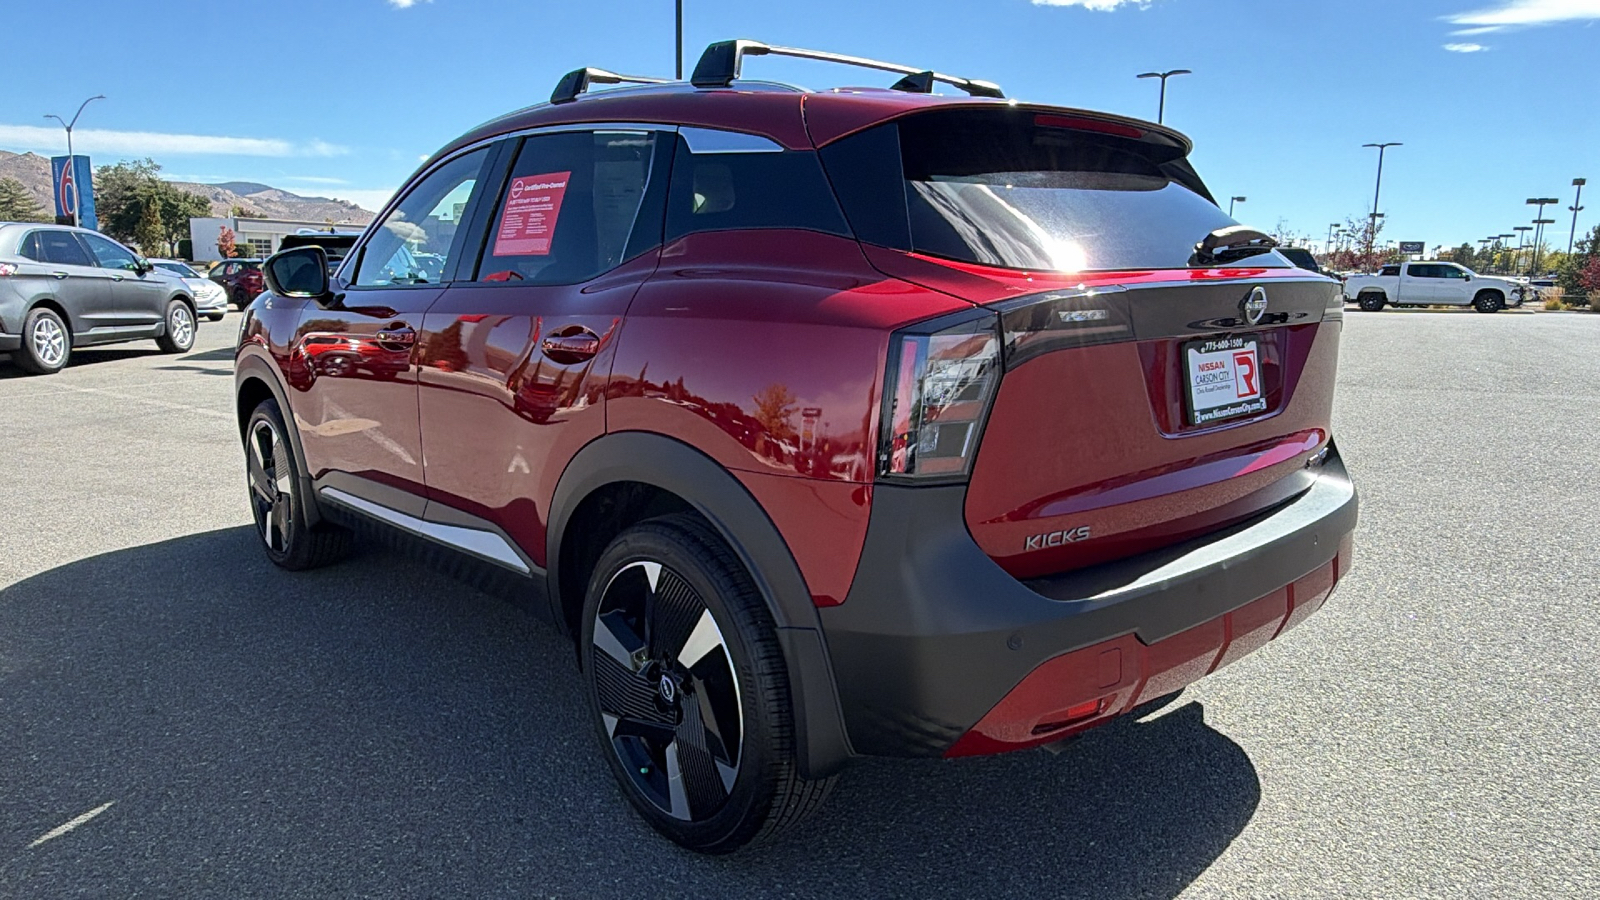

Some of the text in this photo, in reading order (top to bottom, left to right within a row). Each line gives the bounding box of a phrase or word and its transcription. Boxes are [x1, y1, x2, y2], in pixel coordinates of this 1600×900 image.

[60, 158, 80, 217] 6
[1205, 338, 1243, 350] 775-600-1500
[1198, 360, 1225, 372] NISSAN
[1195, 370, 1230, 385] CARSON CITY
[1025, 526, 1091, 551] KICKS
